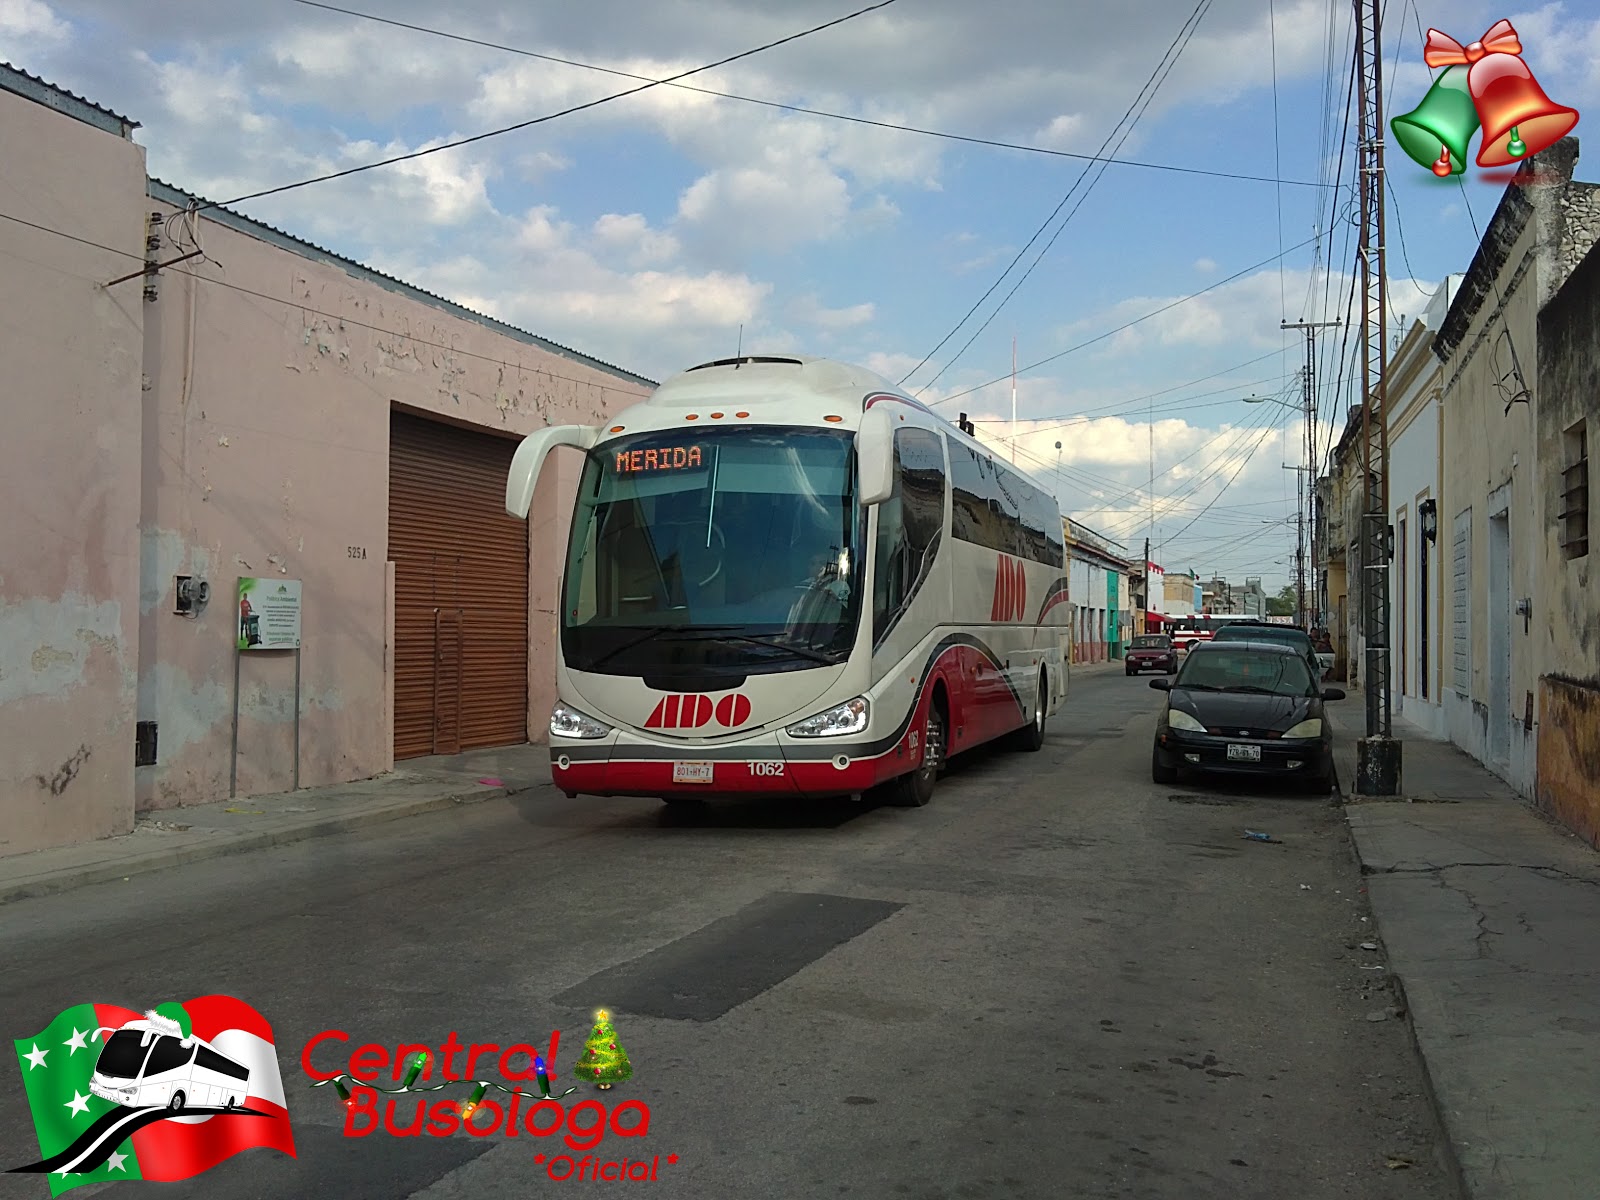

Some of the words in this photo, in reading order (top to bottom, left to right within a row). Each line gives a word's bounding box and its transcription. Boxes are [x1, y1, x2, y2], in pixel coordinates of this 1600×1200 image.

[616, 445, 701, 472] MERIDA
[990, 553, 1027, 623] ADO
[643, 693, 752, 728] ADO
[747, 762, 785, 776] 1062
